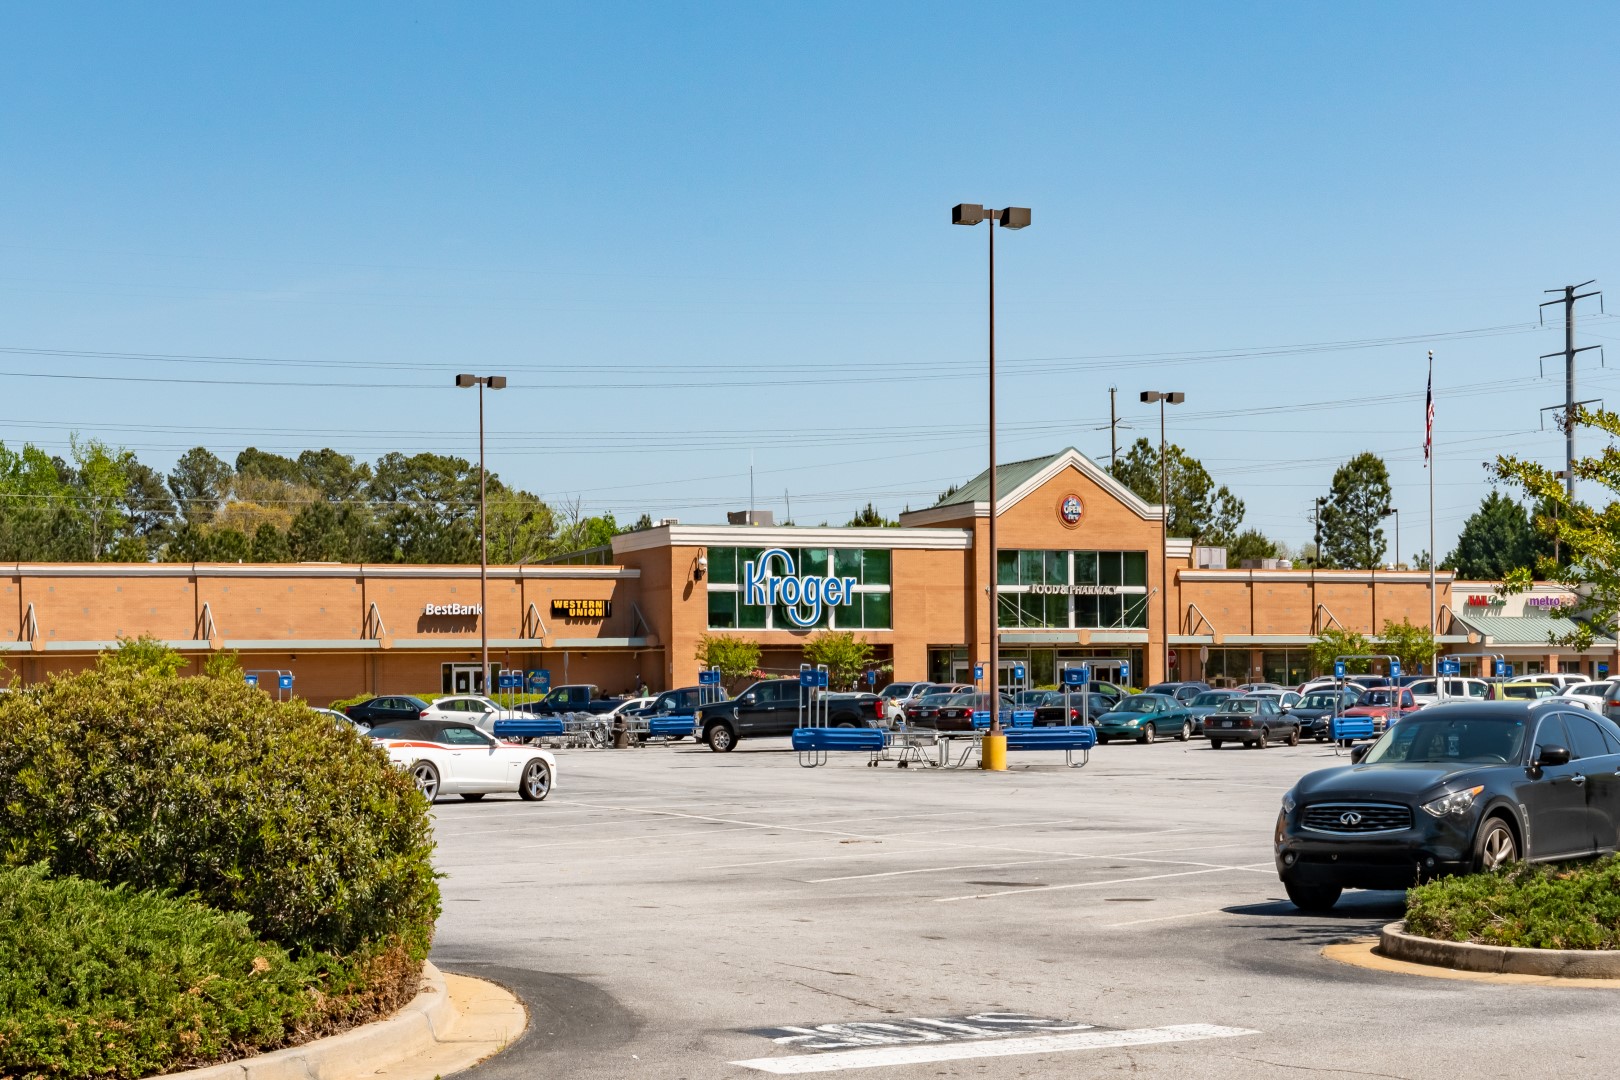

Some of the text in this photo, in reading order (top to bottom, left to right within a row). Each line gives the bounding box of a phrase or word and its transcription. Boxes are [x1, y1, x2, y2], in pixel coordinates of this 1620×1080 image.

[1063, 505, 1082, 514] OPEN
[744, 548, 857, 627] Kroger
[1031, 584, 1118, 595] FOOD & PHARMACY
[554, 600, 602, 608] WESTERN
[1468, 595, 1488, 606] NAIL
[425, 604, 482, 616] BestBank
[568, 608, 602, 616] UNION
